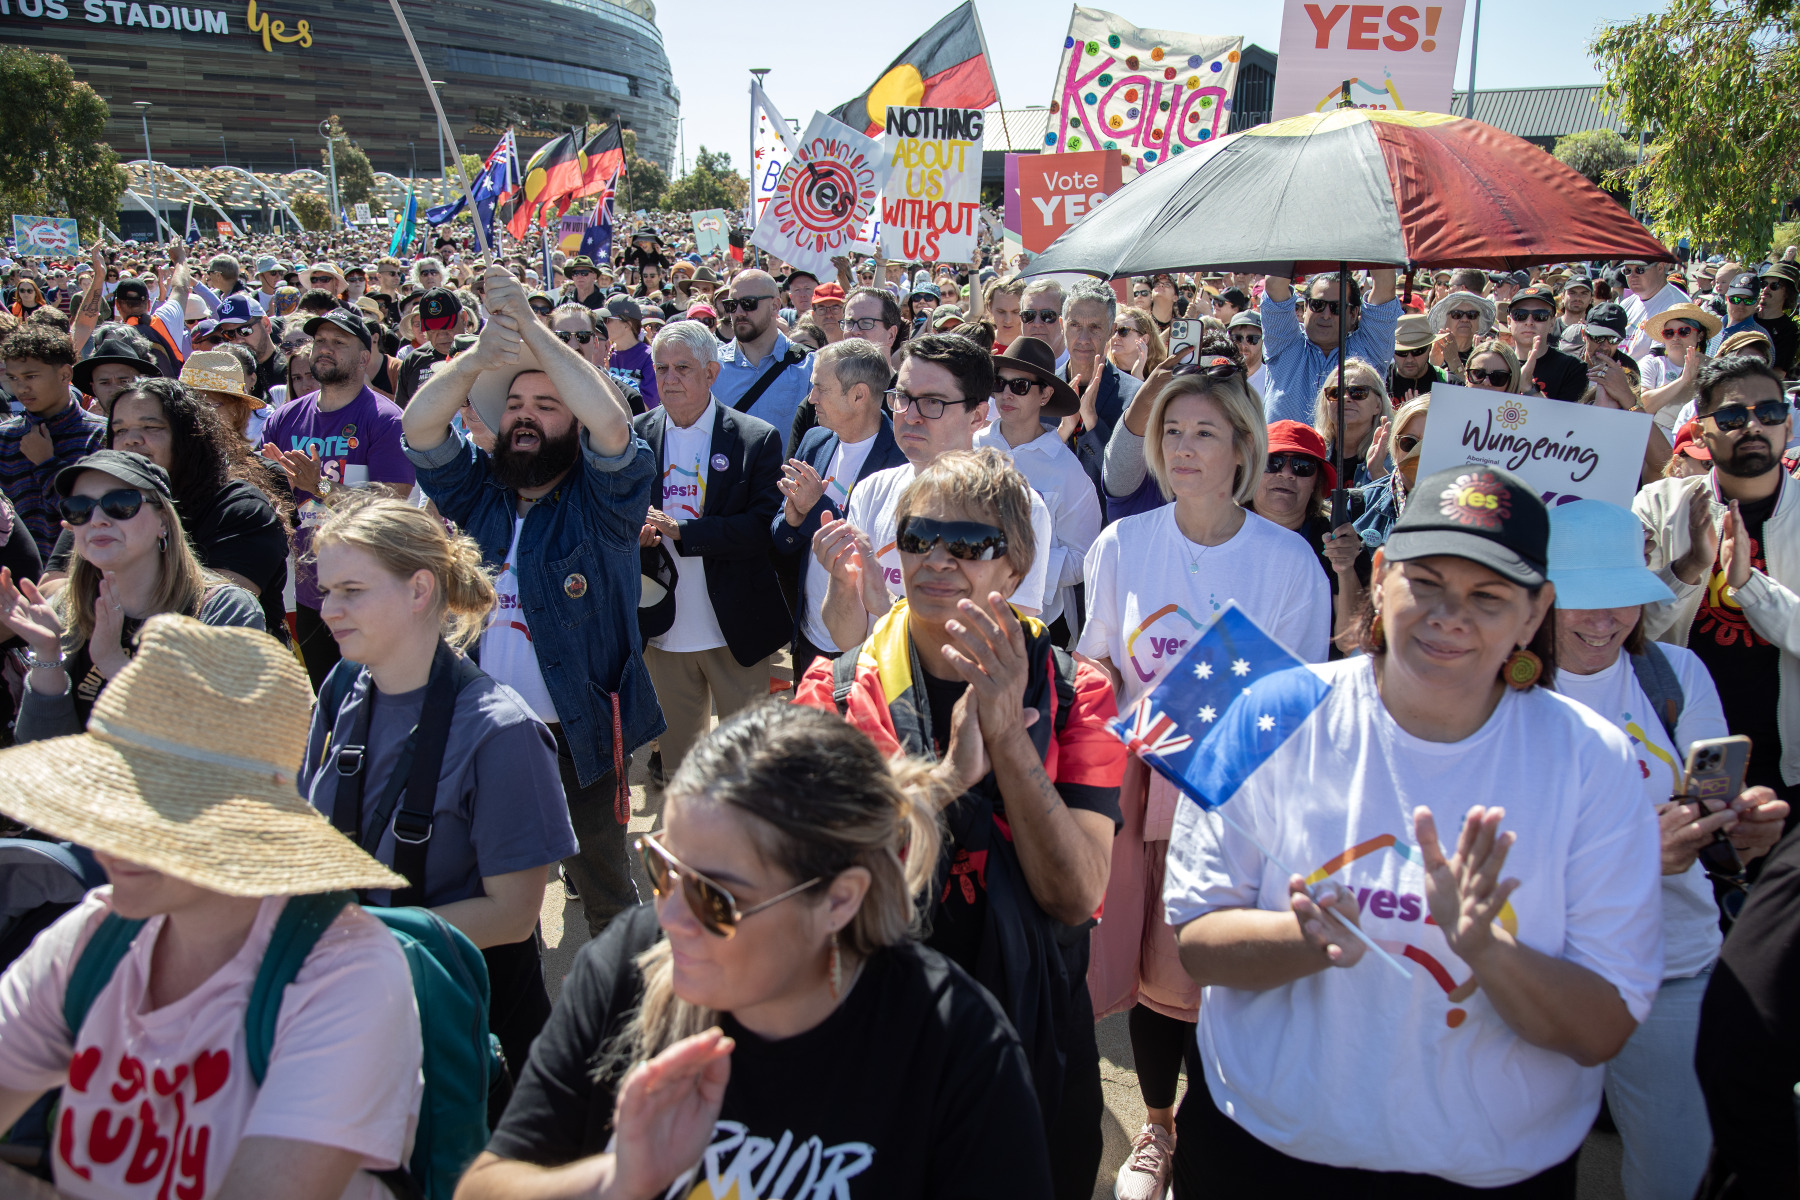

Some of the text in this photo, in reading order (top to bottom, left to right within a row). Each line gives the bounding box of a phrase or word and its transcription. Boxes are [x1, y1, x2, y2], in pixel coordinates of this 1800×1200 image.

[83, 0, 229, 35] STADIUM
[1303, 4, 1443, 53] YES!
[886, 106, 983, 141] NOTHING
[1055, 39, 1228, 174] Kaya
[891, 137, 974, 173] ABOUT
[806, 162, 855, 218] Yes
[906, 168, 943, 202] US
[1043, 171, 1098, 191] Vote
[882, 196, 980, 236] WITHOUT
[902, 229, 941, 262] US
[291, 435, 349, 458] VOTE
[1462, 408, 1599, 483] Wungening
[1466, 454, 1500, 465] Aboriginal
[1458, 487, 1499, 510] Yes
